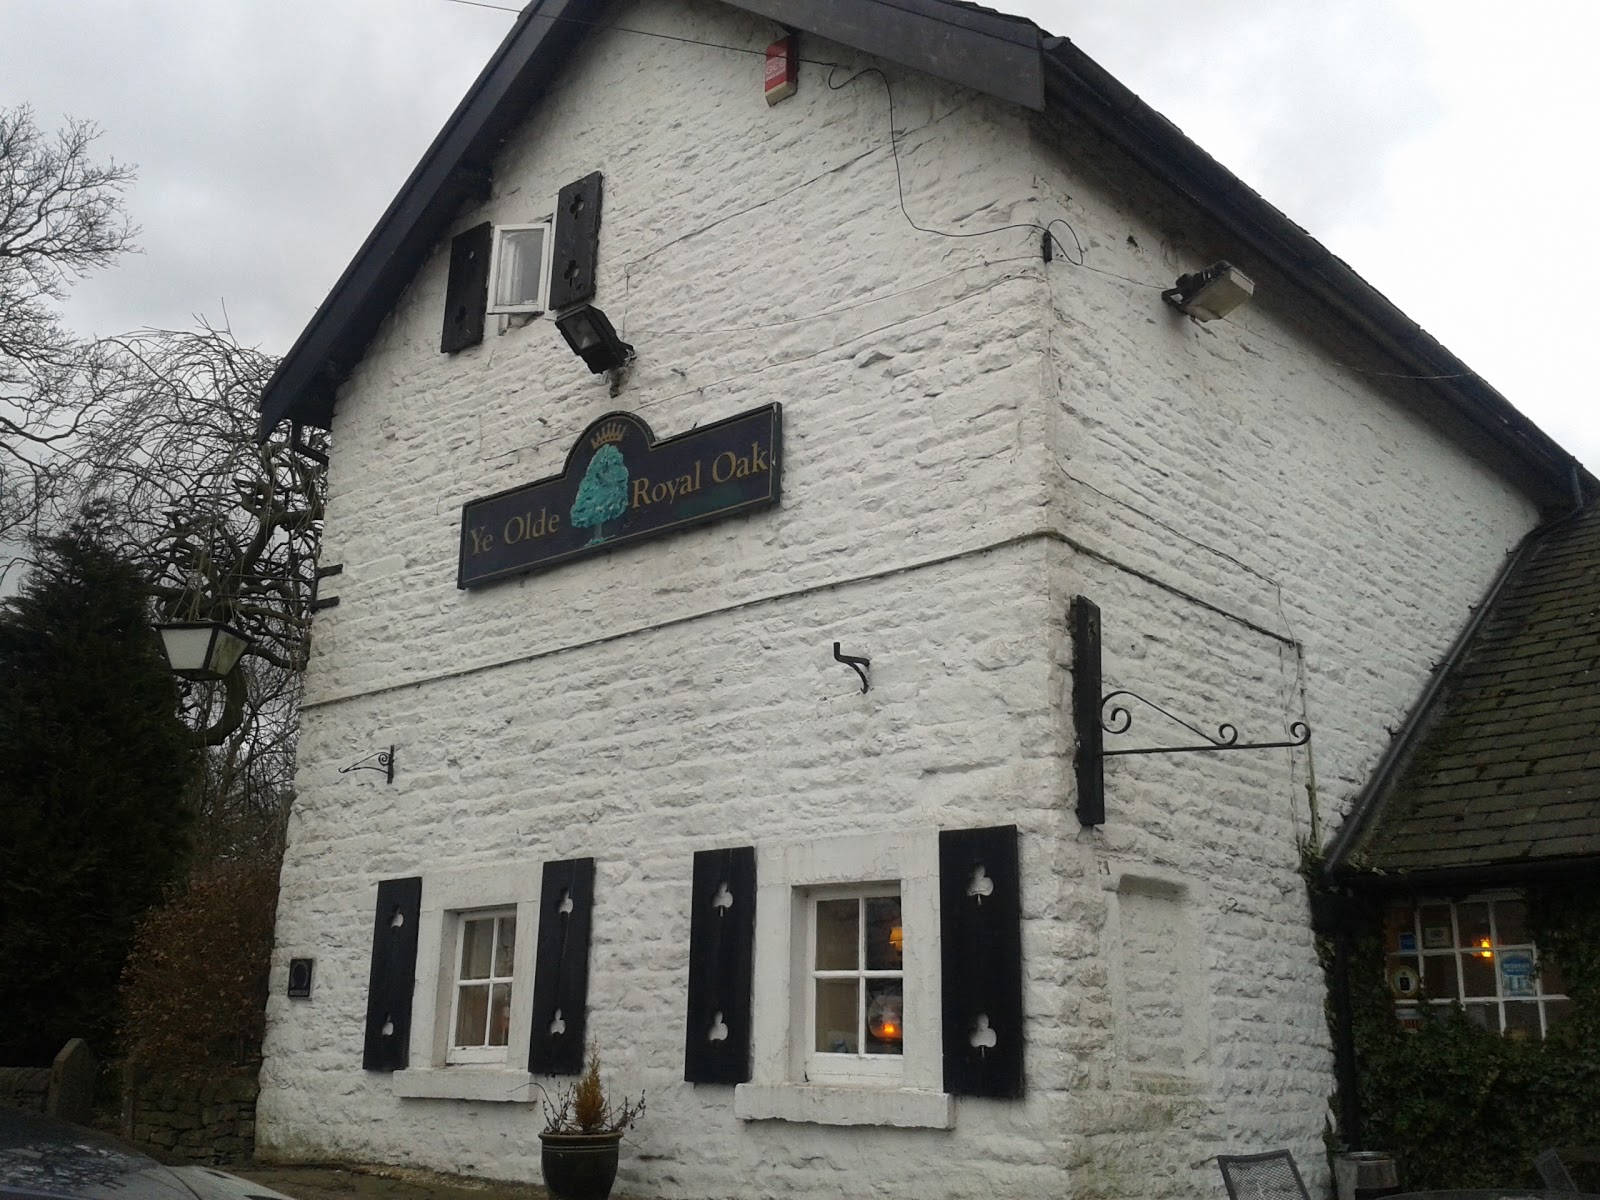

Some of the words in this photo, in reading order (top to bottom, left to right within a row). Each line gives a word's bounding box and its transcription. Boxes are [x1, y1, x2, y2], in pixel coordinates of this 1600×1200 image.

[469, 525, 494, 555] Ye
[503, 508, 560, 545] Olde
[632, 461, 700, 509] Royal
[711, 441, 769, 484] Oak
